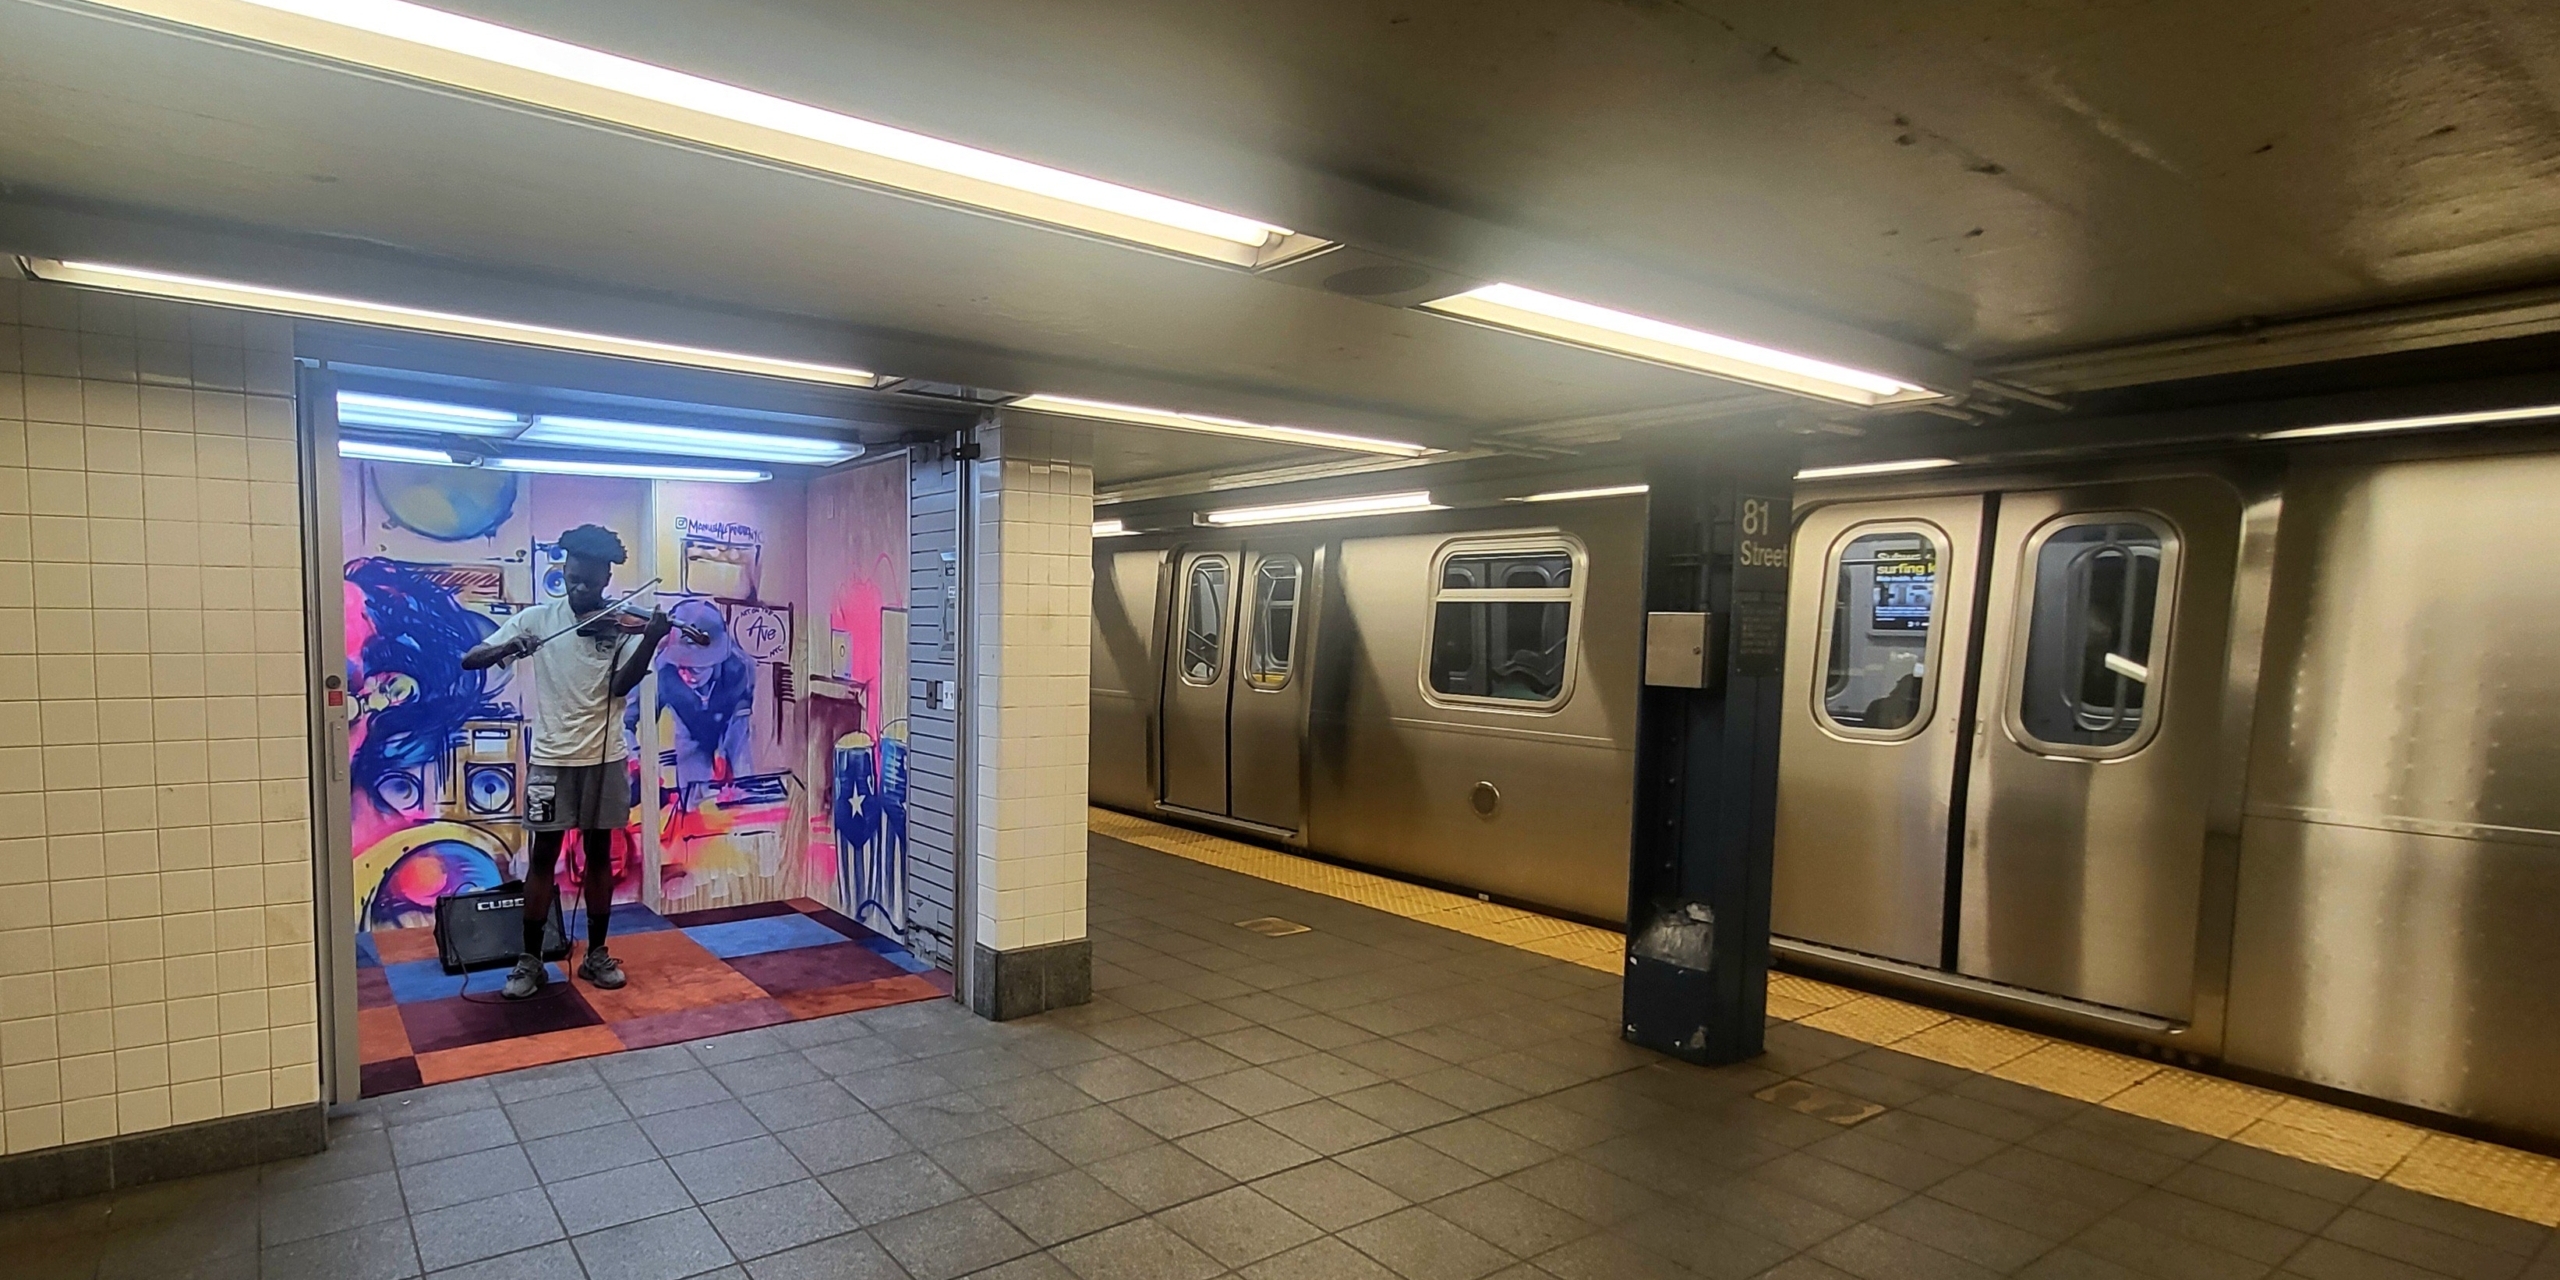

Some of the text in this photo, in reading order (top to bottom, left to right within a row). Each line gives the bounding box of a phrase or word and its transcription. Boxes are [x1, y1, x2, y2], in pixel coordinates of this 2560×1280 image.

[1742, 499, 1769, 535] 81
[1740, 540, 1788, 568] Street
[1876, 563, 1926, 576] surfing
[746, 615, 777, 651] Ave
